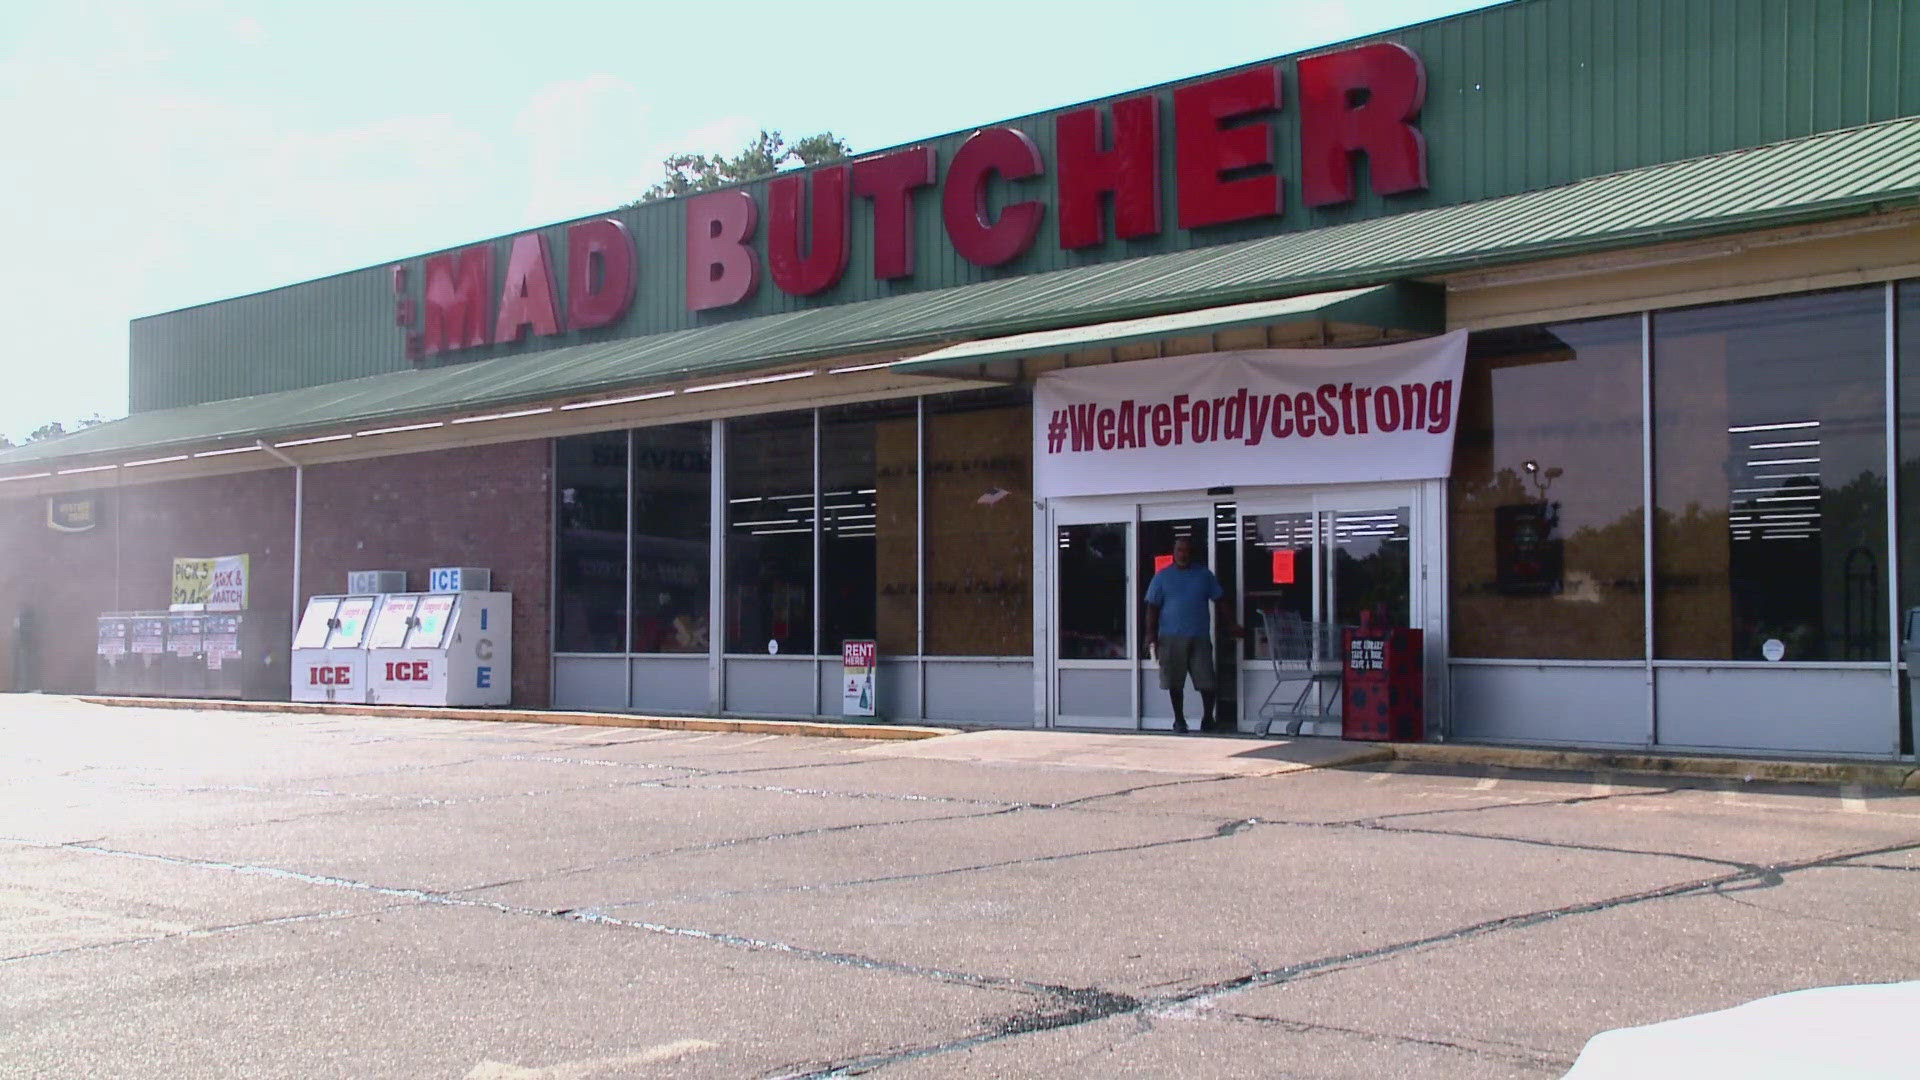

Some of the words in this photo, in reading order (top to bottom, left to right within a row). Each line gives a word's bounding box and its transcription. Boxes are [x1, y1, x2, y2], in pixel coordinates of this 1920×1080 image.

[424, 219, 638, 357] MAD
[687, 41, 1428, 312] BUTCHER
[1047, 379, 1453, 454] #WeAreFordyceStrong
[175, 563, 199, 580] PICK
[214, 570, 233, 588] MIX
[235, 569, 243, 586] &
[432, 570, 459, 591] ICE
[350, 573, 377, 593] ICE
[212, 589, 243, 603] MATCH
[475, 608, 493, 689] ICE
[845, 643, 874, 657] RENT
[1364, 650, 1370, 660] A
[845, 656, 865, 666] HERE
[1365, 660, 1370, 669] A
[309, 667, 351, 685] ICE
[386, 662, 429, 681] ICE
